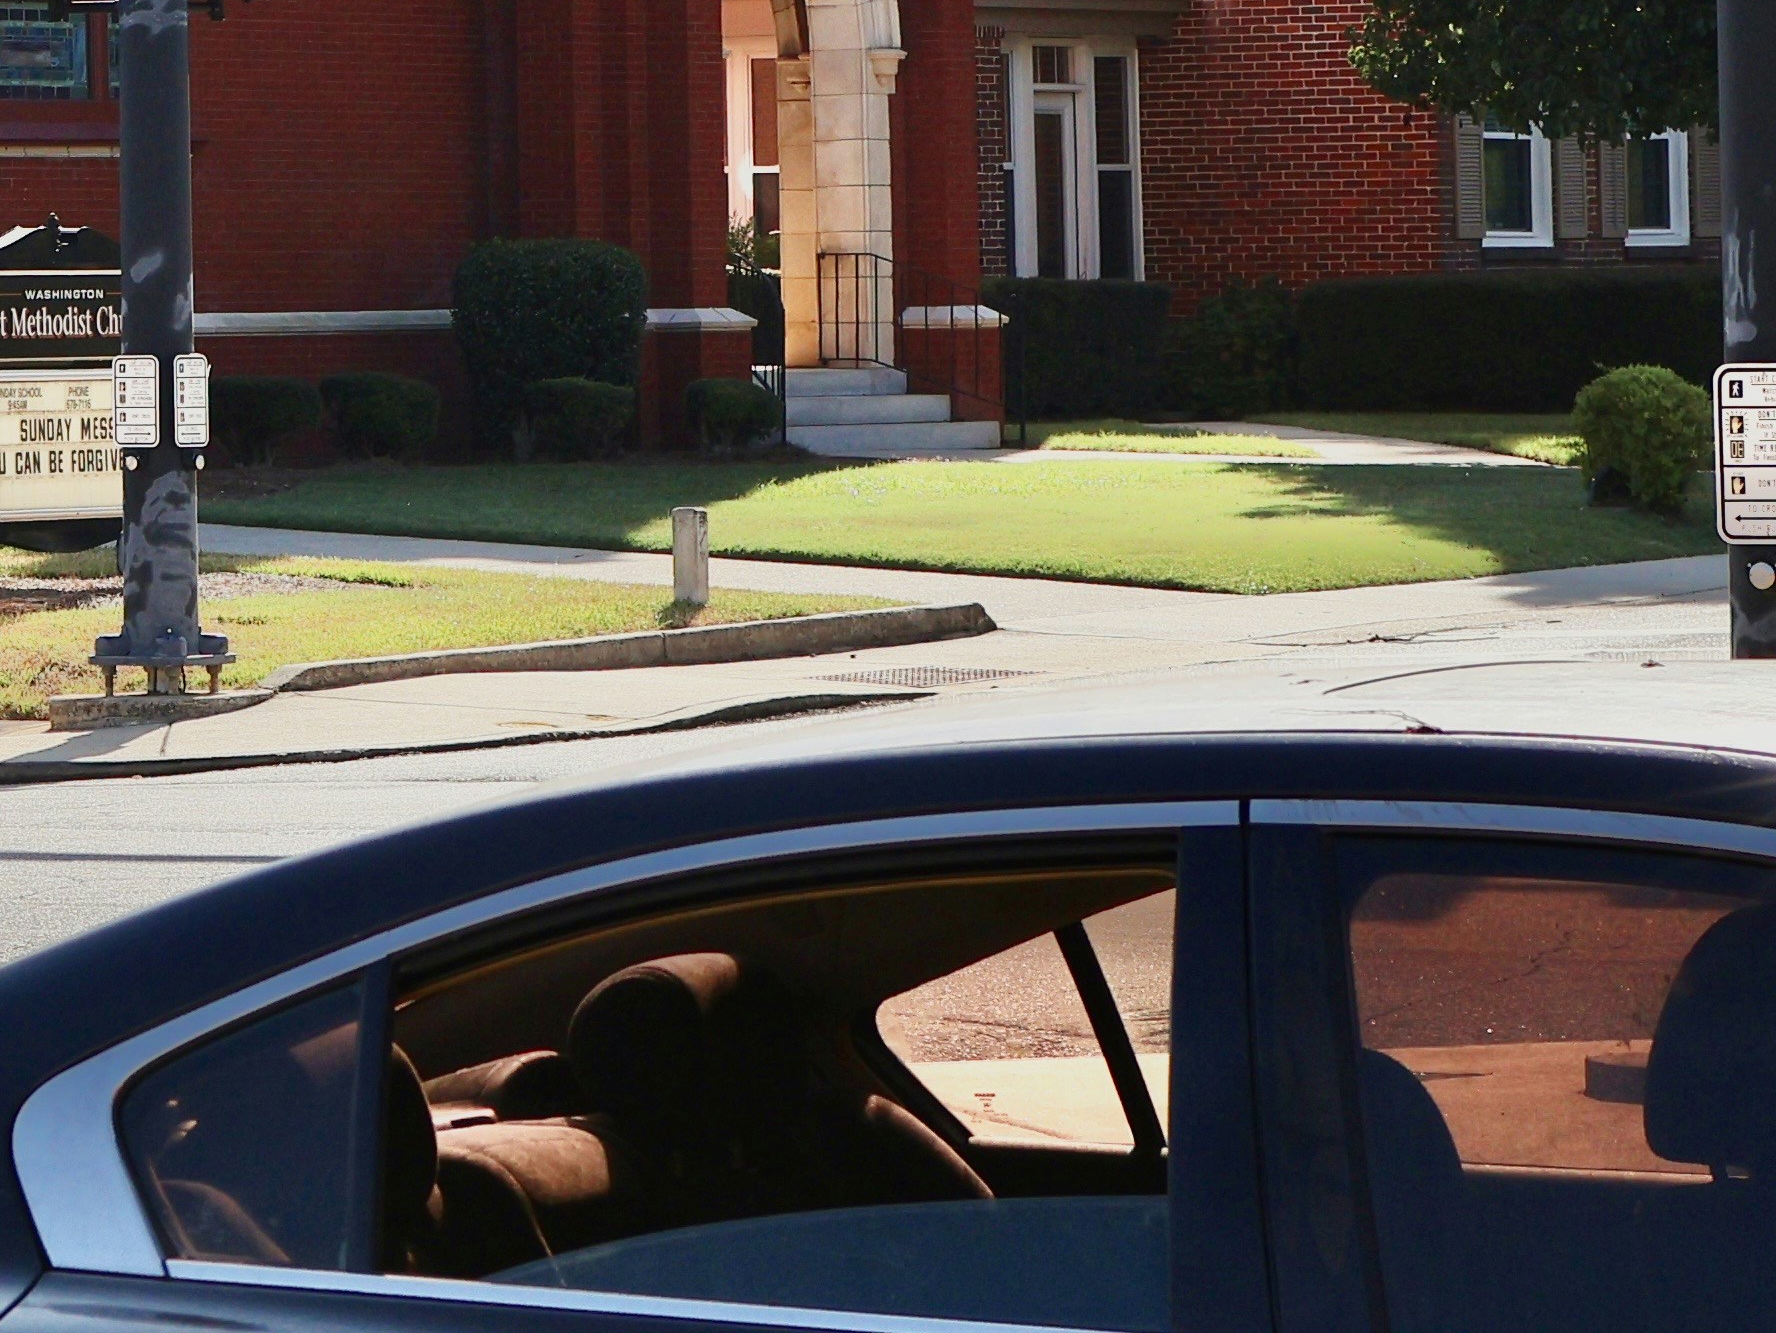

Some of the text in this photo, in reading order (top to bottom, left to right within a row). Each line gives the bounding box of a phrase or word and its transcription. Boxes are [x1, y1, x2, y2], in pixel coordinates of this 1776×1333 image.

[24, 288, 104, 301] WASHINGTON
[10, 305, 93, 338] Methodist
[17, 386, 43, 399] SCHOOL
[67, 385, 89, 397] PHONE
[20, 418, 72, 443] SUNDAY
[15, 450, 42, 475] CAN
[48, 449, 64, 474] BE
